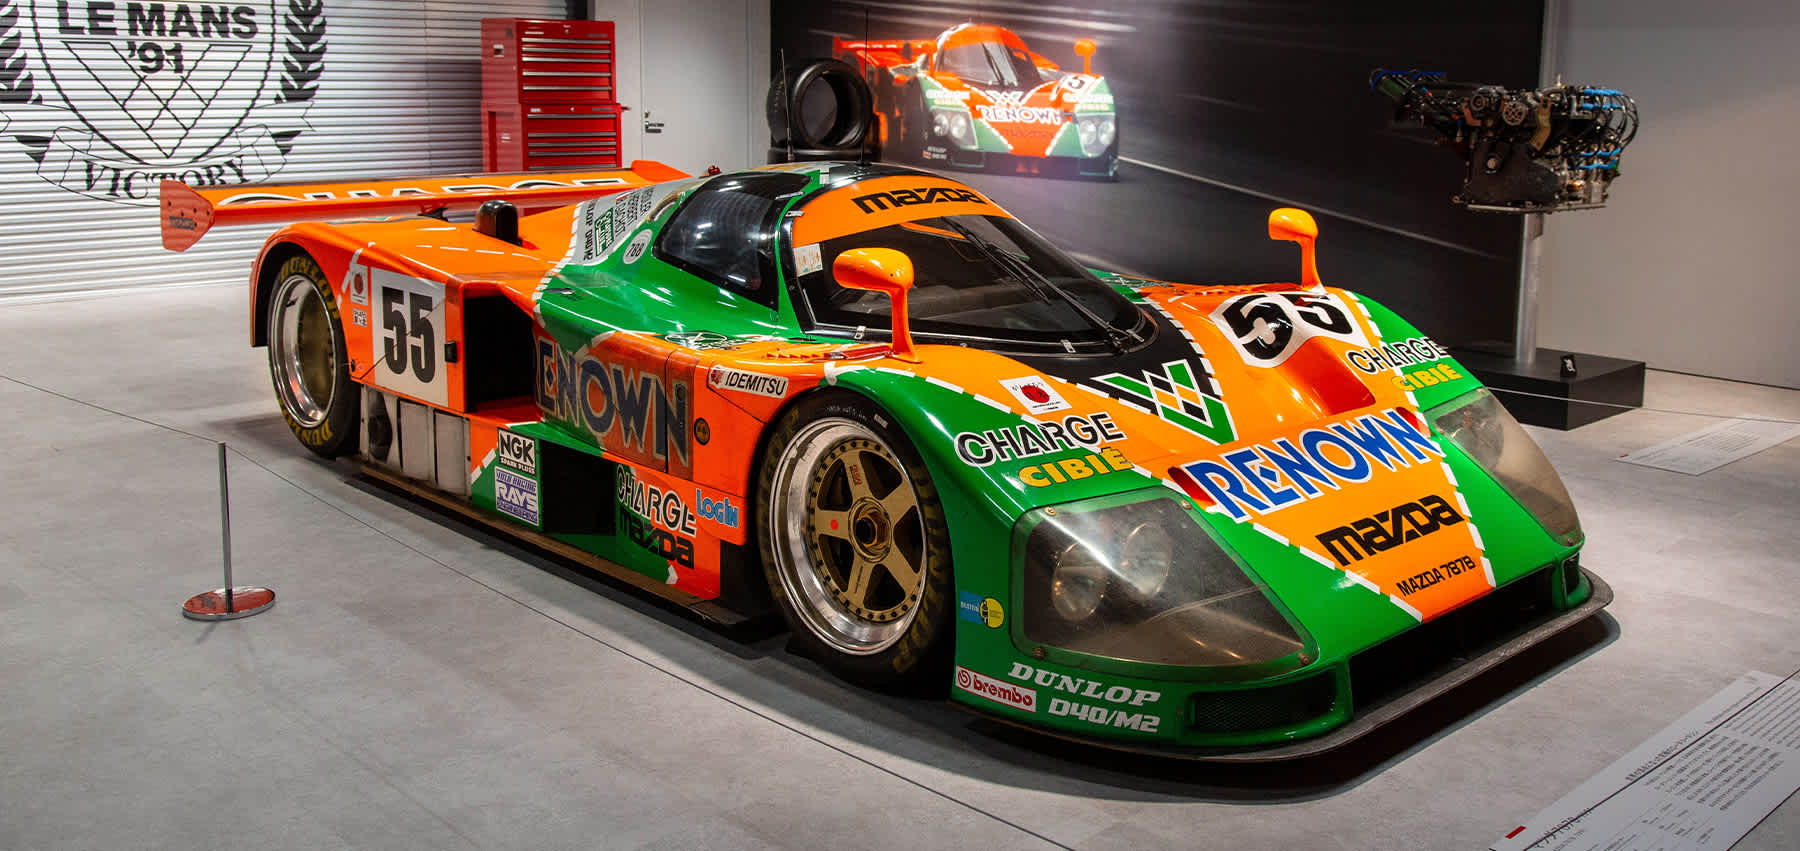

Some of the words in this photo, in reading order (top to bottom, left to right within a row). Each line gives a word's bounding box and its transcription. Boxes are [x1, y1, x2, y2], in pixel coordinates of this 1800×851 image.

[57, 0, 118, 35] LE
[127, 2, 258, 39] MANS
[382, 286, 435, 383] 55
[1222, 293, 1353, 361] 55
[1346, 337, 1452, 374] CHARGE
[536, 337, 689, 468] ENOWN
[724, 370, 787, 397] IDEMITSU
[500, 433, 535, 466] NGK
[954, 412, 1128, 467] CHARGE
[1180, 408, 1446, 524] RENOWN
[497, 482, 538, 513] RAYS
[617, 464, 697, 538] CHARGE
[1396, 567, 1444, 597] MAZDA
[1440, 555, 1476, 584] 787B
[973, 675, 1033, 707] brembo
[1008, 662, 1160, 707] DUNLOP
[1048, 698, 1160, 733] D40/M2
